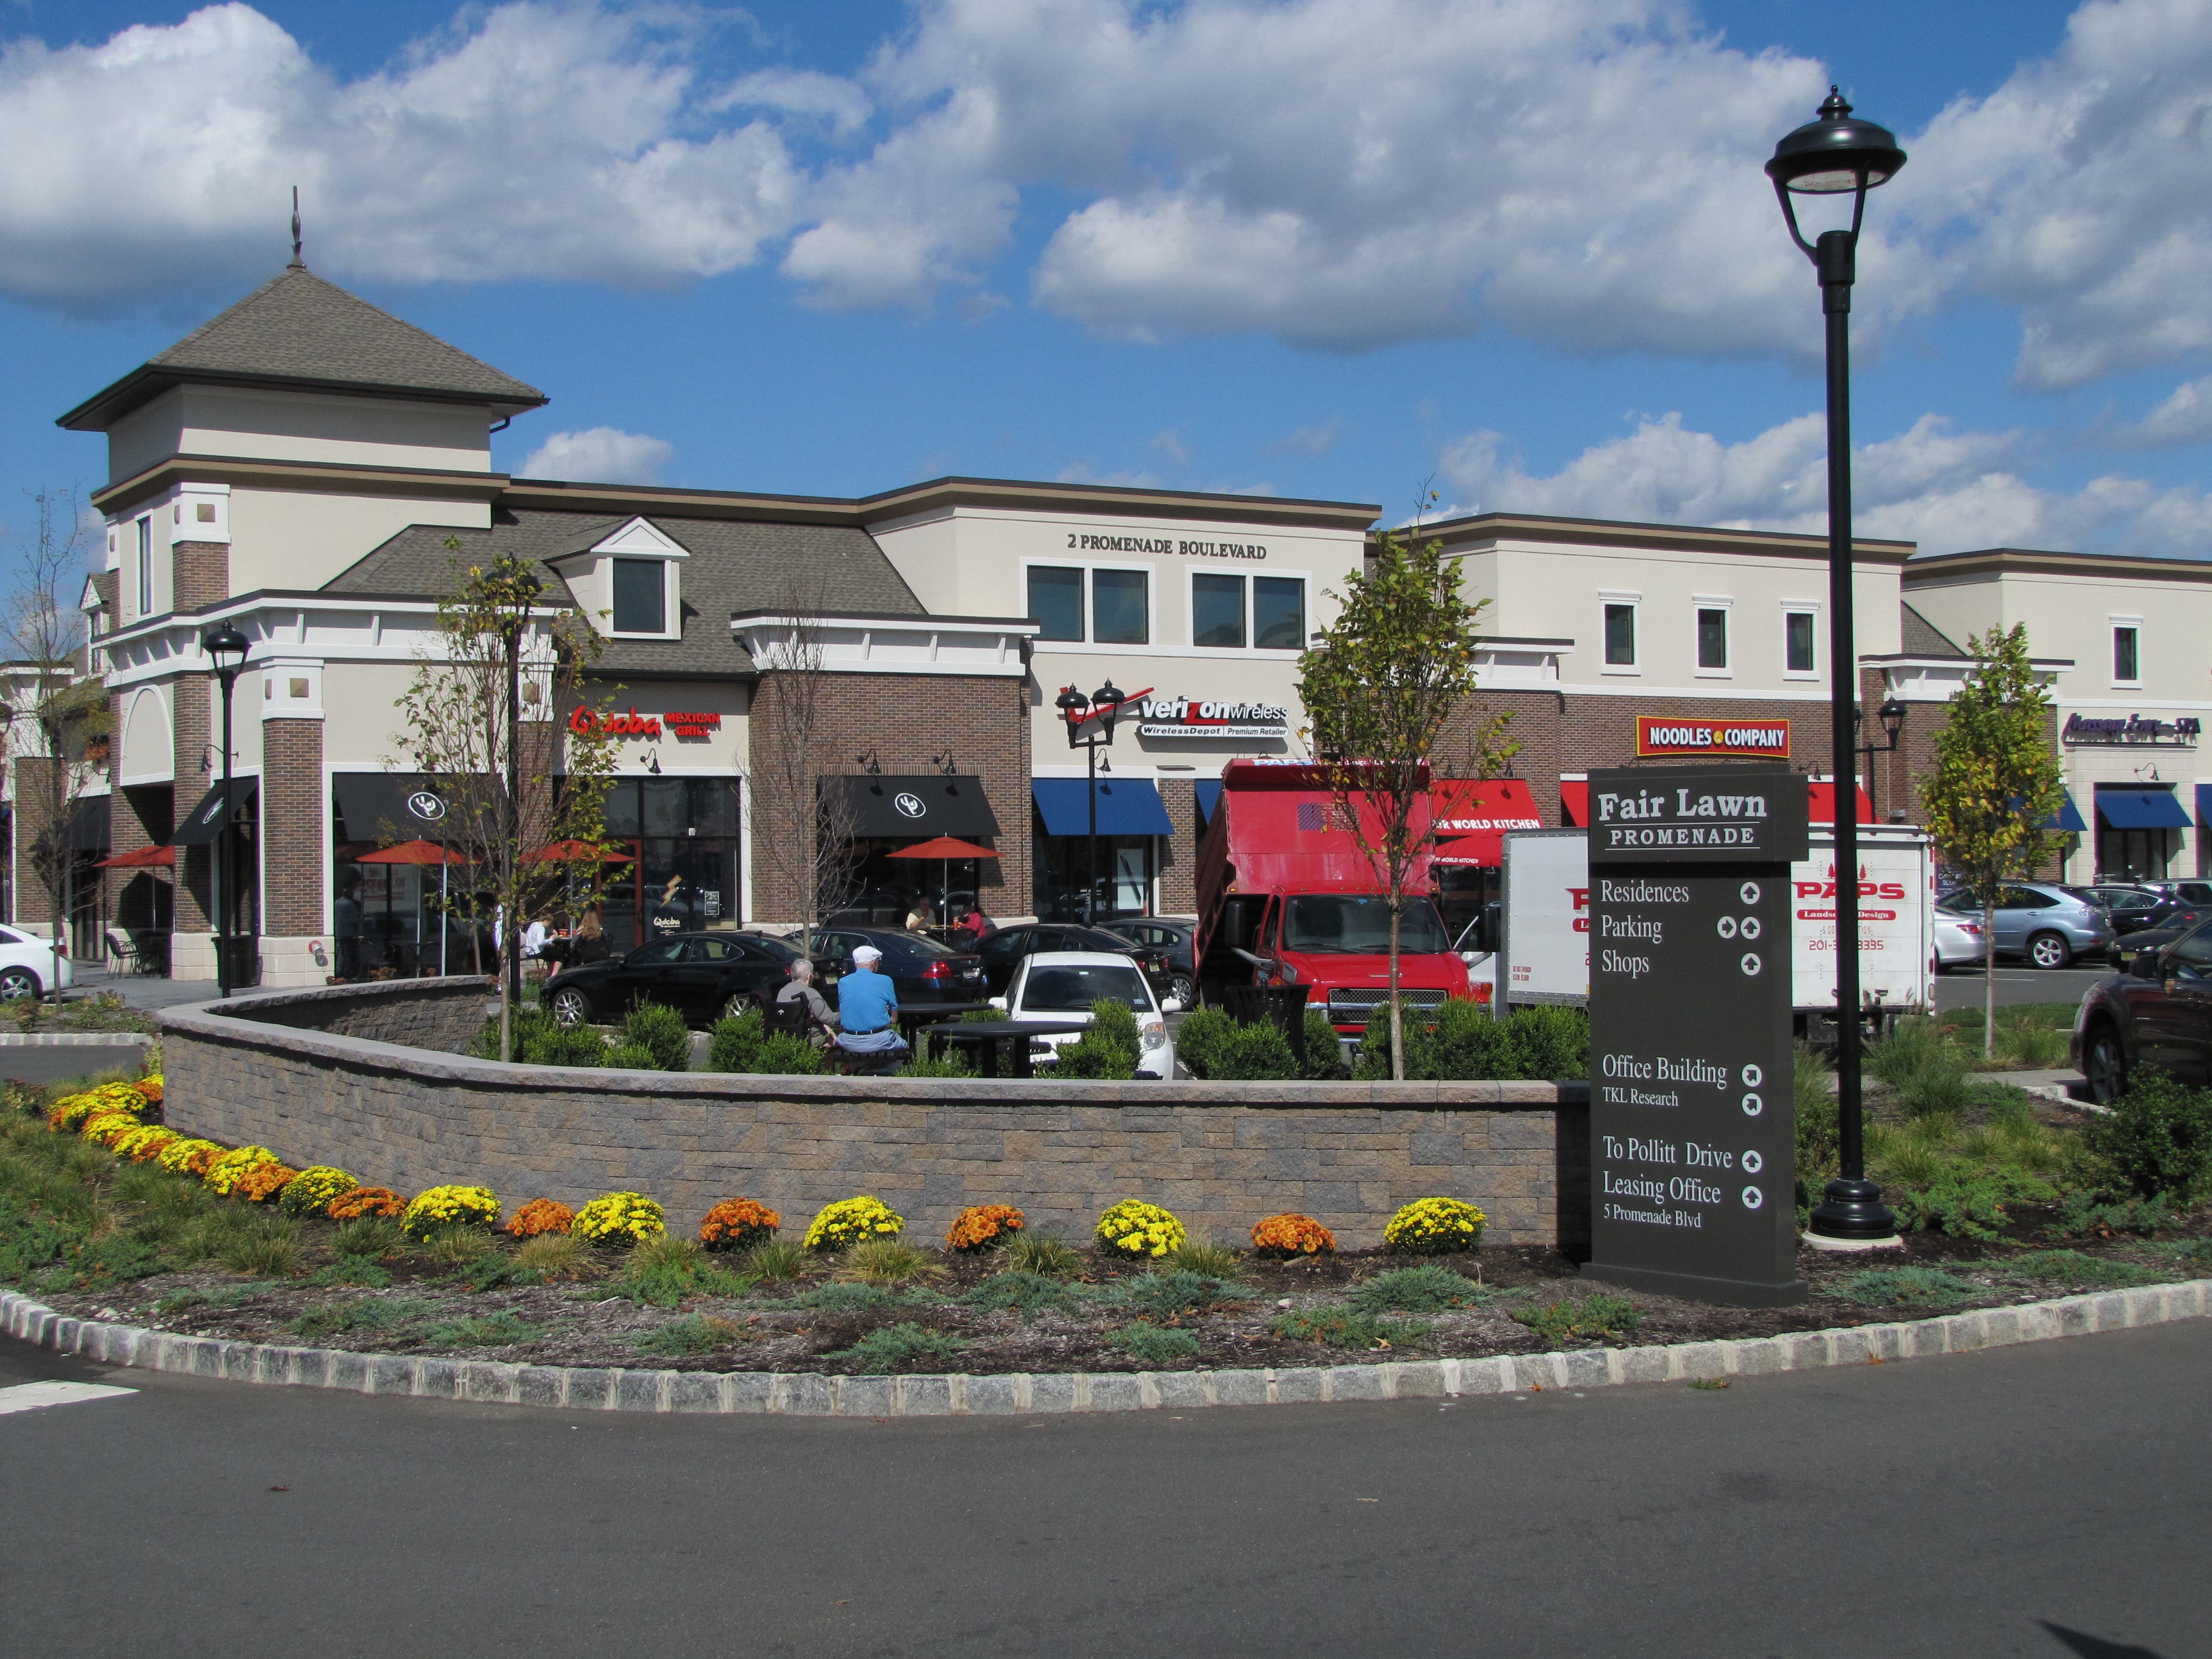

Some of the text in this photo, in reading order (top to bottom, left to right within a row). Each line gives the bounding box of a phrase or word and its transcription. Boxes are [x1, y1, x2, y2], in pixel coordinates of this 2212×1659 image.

[1067, 534, 1267, 559] 2 PROMENADE BOULEVARD
[665, 712, 721, 723] MEXICAN
[675, 726, 711, 736] GRILL
[1144, 727, 1220, 735] WirelessDepot
[1650, 727, 1712, 745] NOODLES
[1724, 729, 1785, 746] COMPANY
[1598, 789, 1767, 821] Fair Lawn
[1452, 819, 1491, 830] WORLD
[1493, 819, 1541, 829] KITCHEN
[1610, 828, 1754, 845] PROMENADE
[1601, 879, 1689, 902] Residences
[653, 917, 681, 927] Qdoba
[1858, 911, 1889, 920] Design
[1601, 915, 1662, 944] Parking
[1602, 950, 1650, 979] Shops
[1603, 1054, 1727, 1090] Office Building
[1603, 1087, 1678, 1107] TKL Research
[1603, 1136, 1733, 1168] To Pollitt Drive
[1603, 1171, 1721, 1204] Leasing Office
[1603, 1203, 1701, 1228] 5 Promenade Blvd
